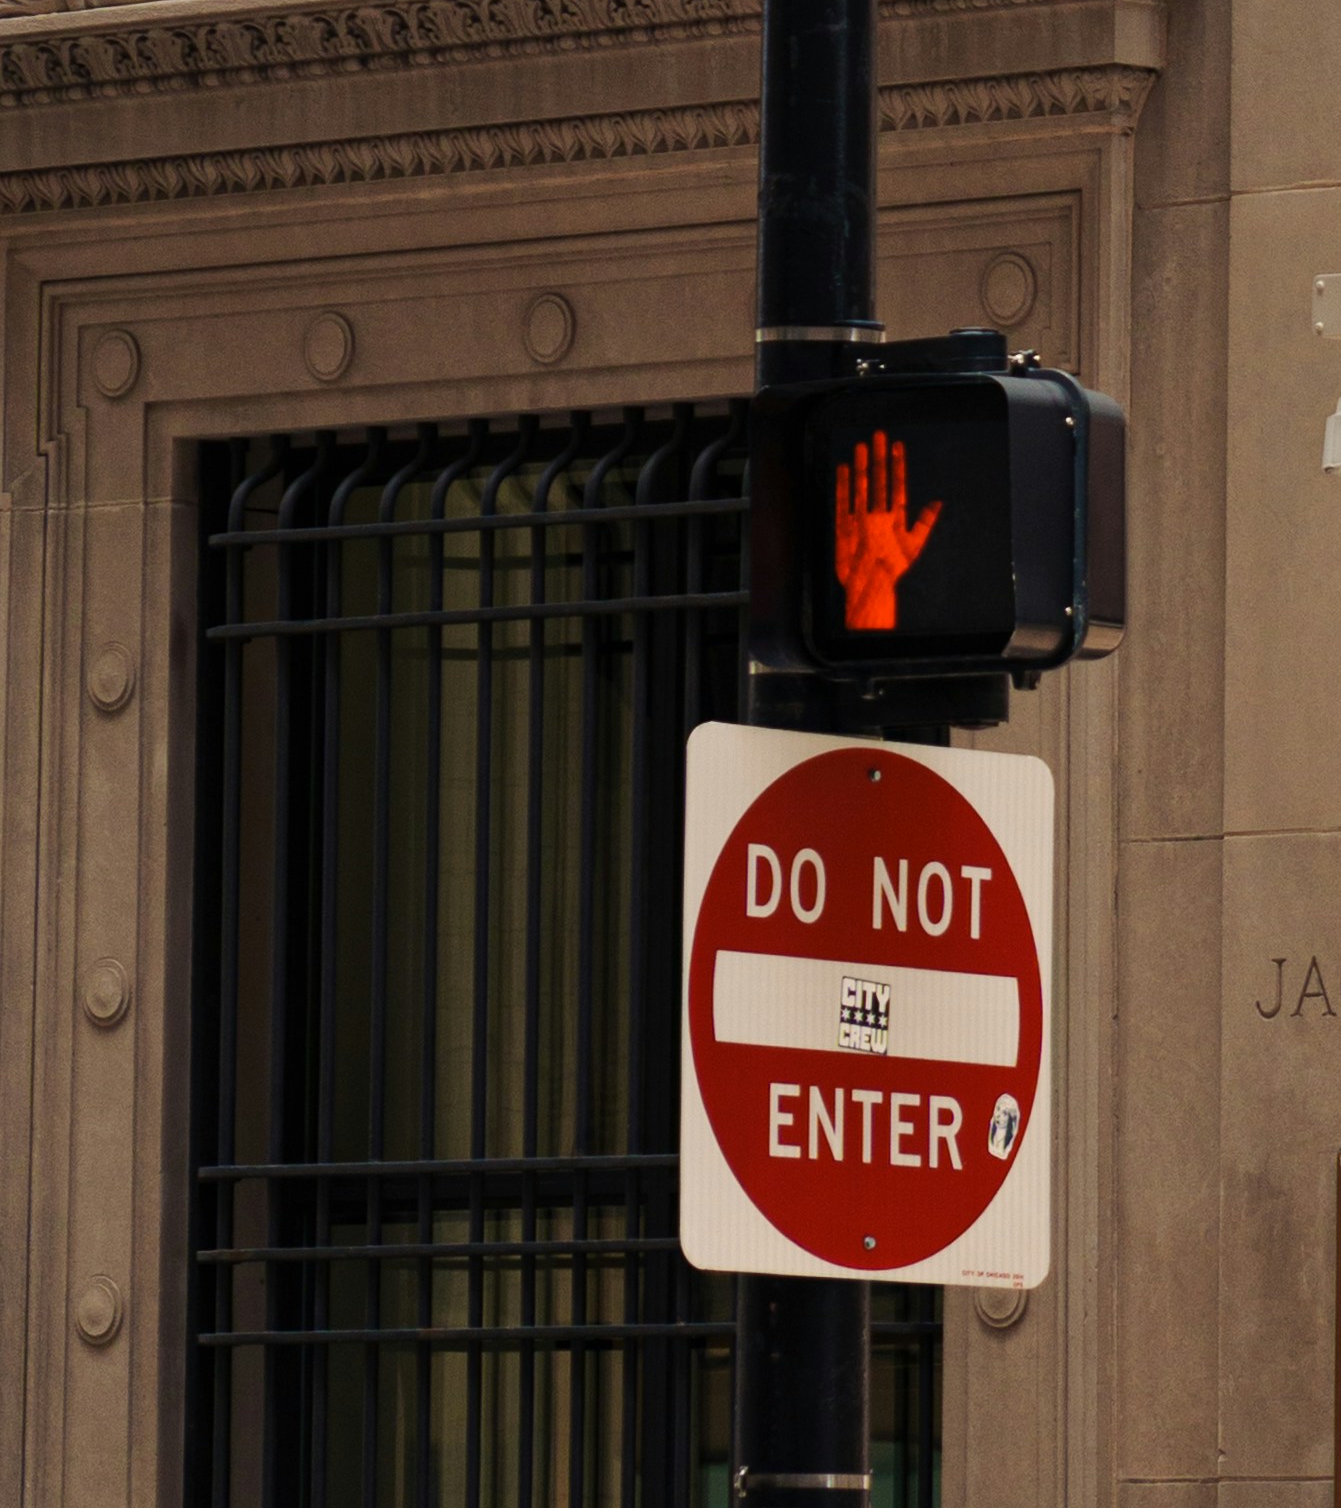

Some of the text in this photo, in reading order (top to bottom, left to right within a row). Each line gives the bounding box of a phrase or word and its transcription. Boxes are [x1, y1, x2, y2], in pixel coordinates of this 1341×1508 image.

[747, 843, 993, 940] DO NOT
[842, 977, 890, 1015] CITY
[838, 1021, 888, 1054] CREW
[769, 1082, 963, 1171] ENTER
